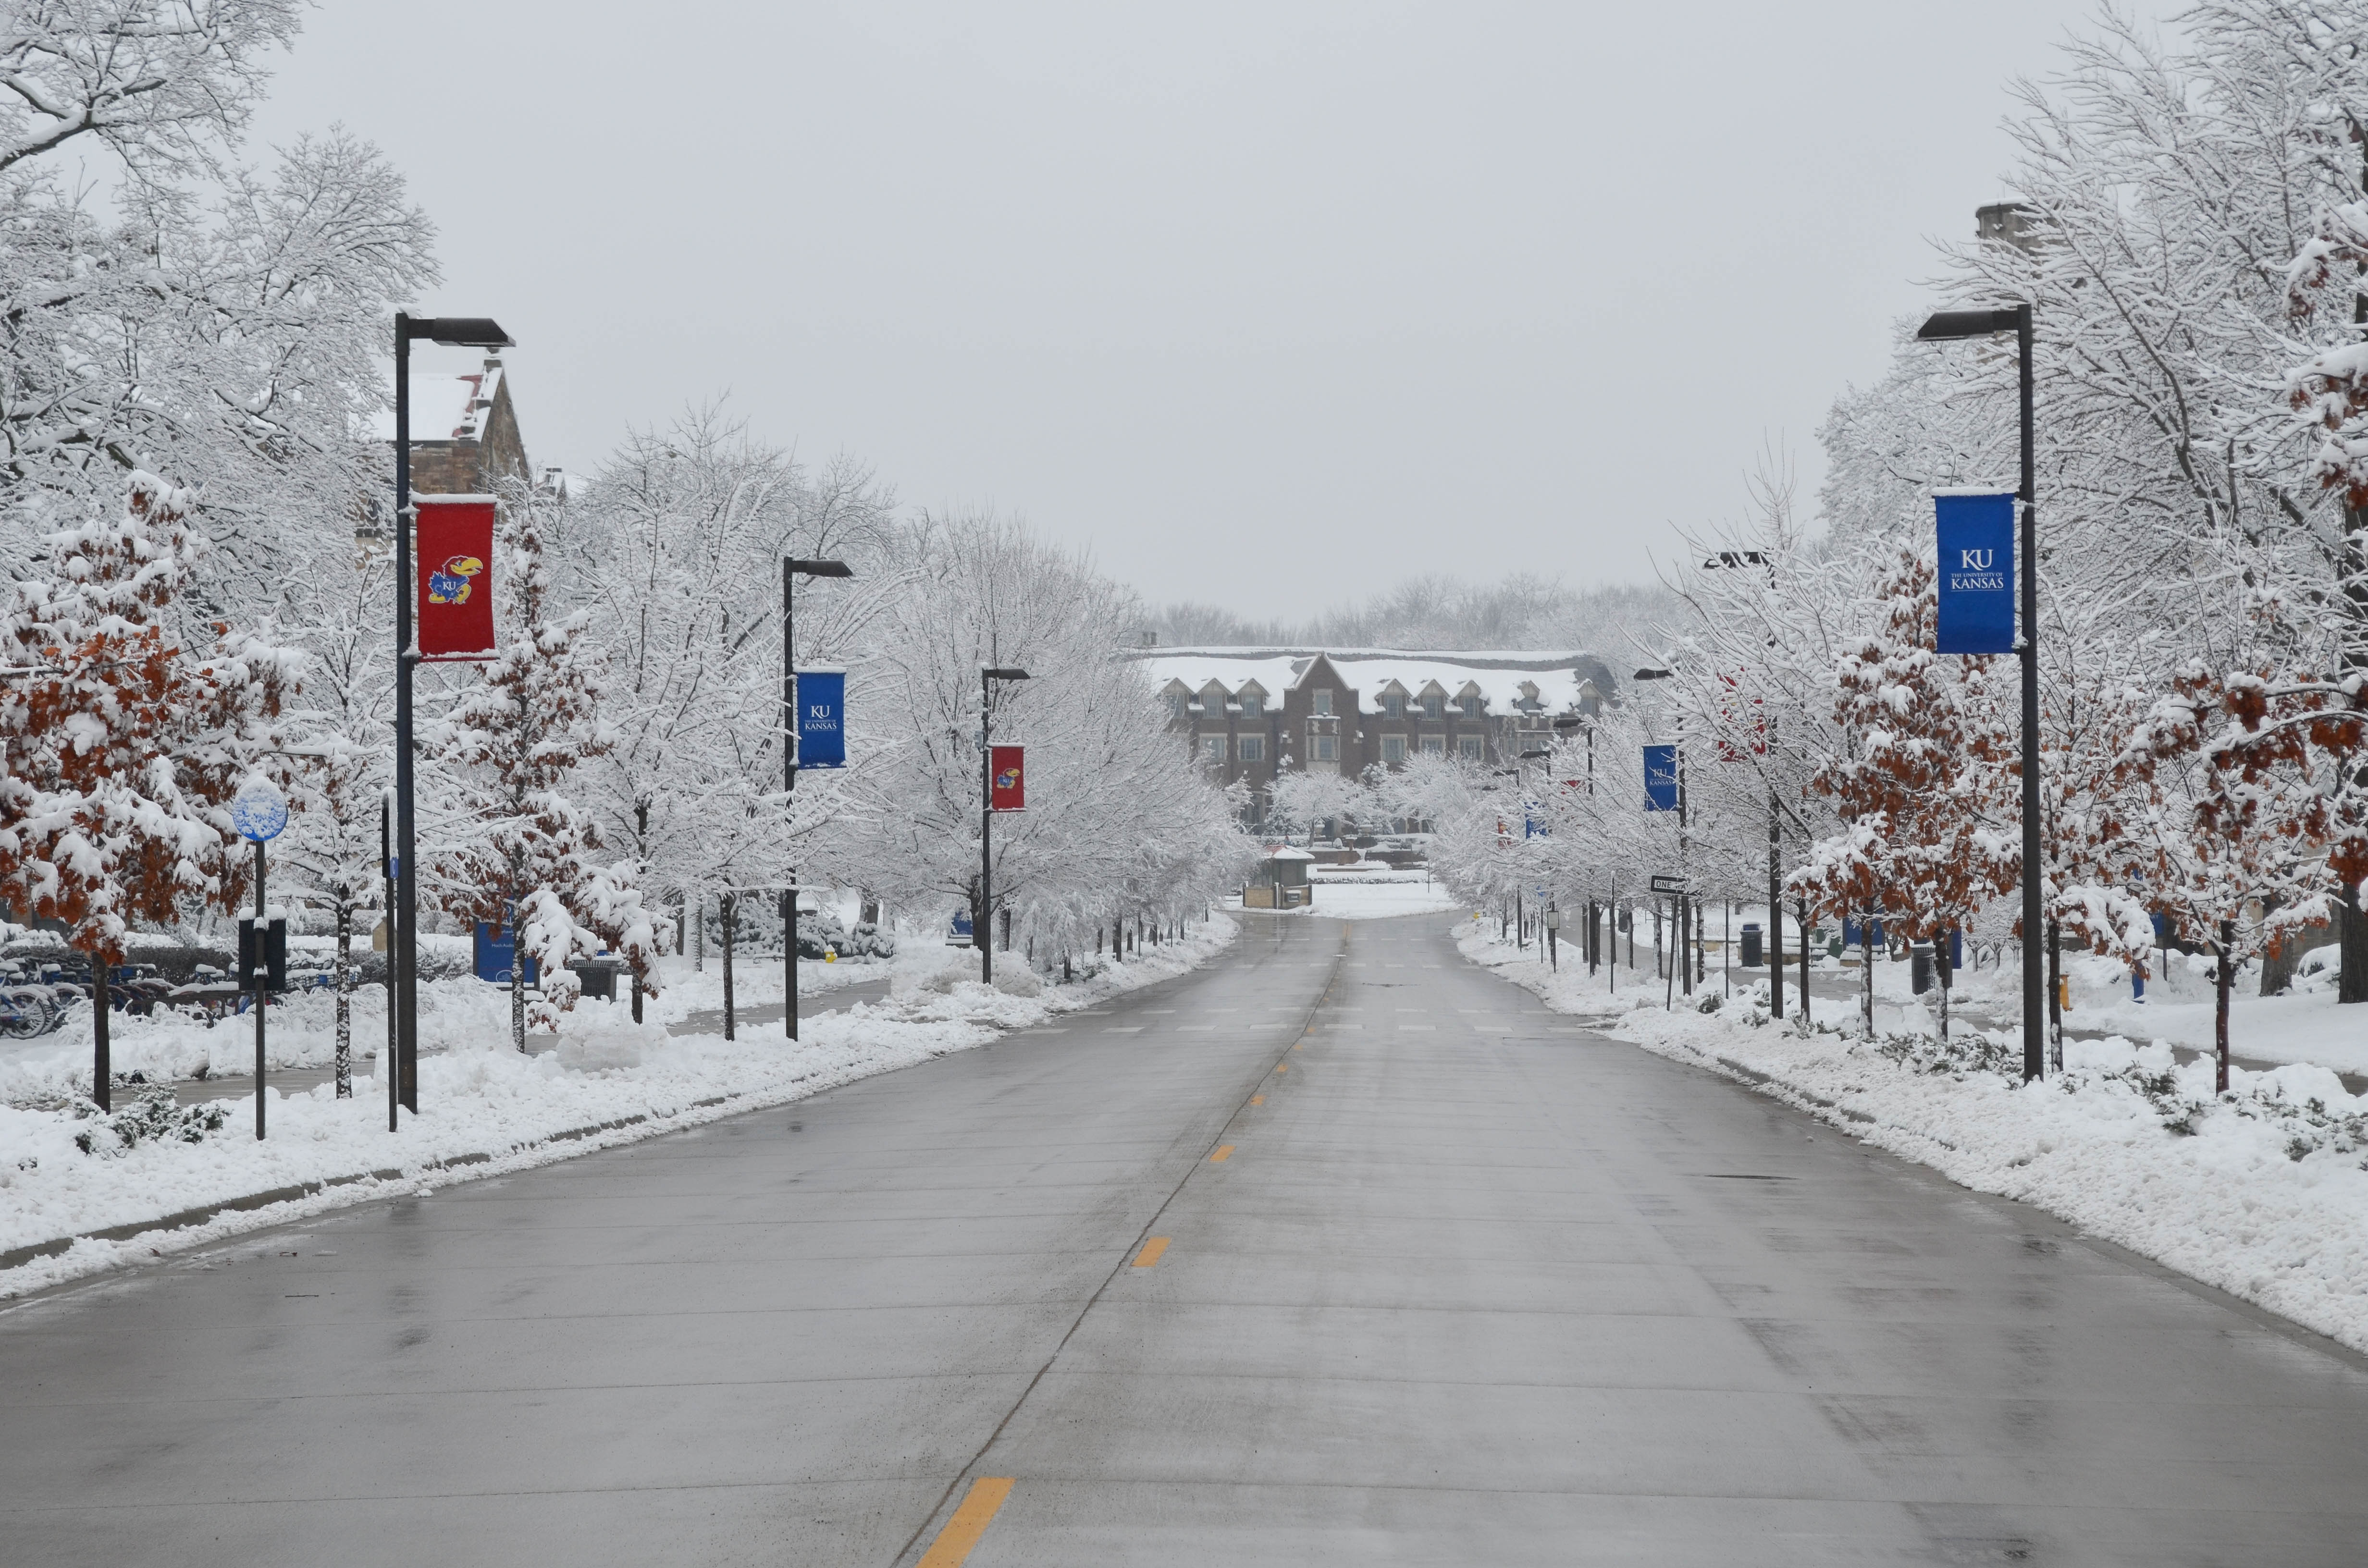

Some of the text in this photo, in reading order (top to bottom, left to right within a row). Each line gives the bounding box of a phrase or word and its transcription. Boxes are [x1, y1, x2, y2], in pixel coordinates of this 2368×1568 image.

[1961, 549, 1994, 571] KU
[443, 582, 456, 591] KU
[1952, 577, 2004, 589] KANSAS
[811, 705, 830, 719] KU
[1654, 769, 1667, 778] KU
[1656, 880, 1672, 889] ONE
